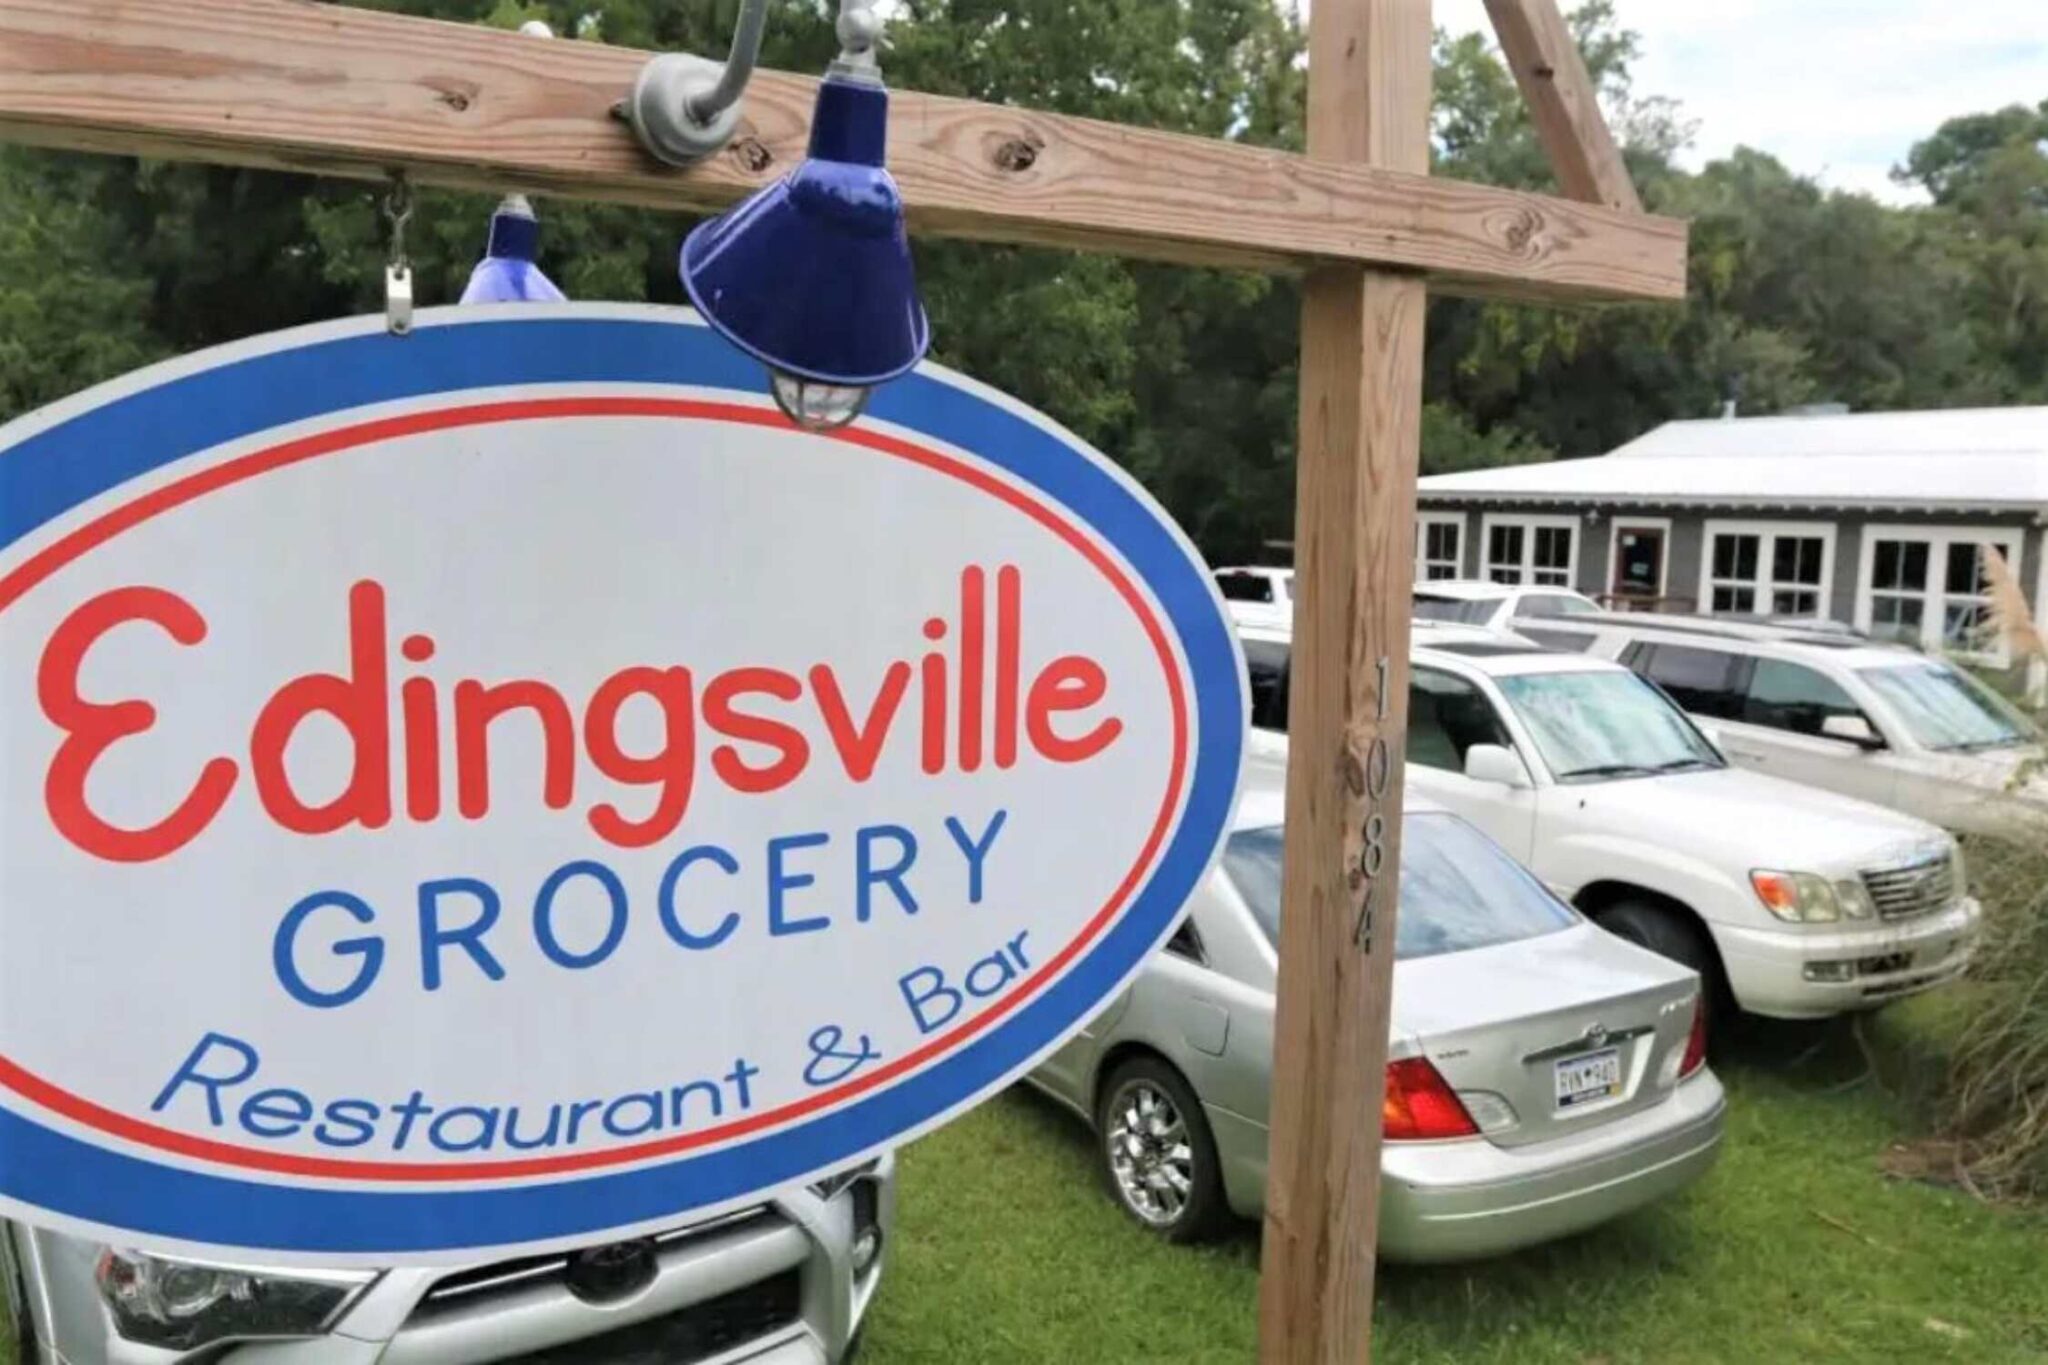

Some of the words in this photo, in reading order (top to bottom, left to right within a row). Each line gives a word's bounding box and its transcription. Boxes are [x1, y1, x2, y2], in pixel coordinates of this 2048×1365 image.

[37, 564, 1123, 863] Edingsville
[1354, 655, 1389, 954] 1084
[273, 810, 1008, 1009] GROCERY
[151, 1031, 759, 1153] Restaurant
[803, 1025, 881, 1087] &
[898, 929, 1033, 1035] Bar
